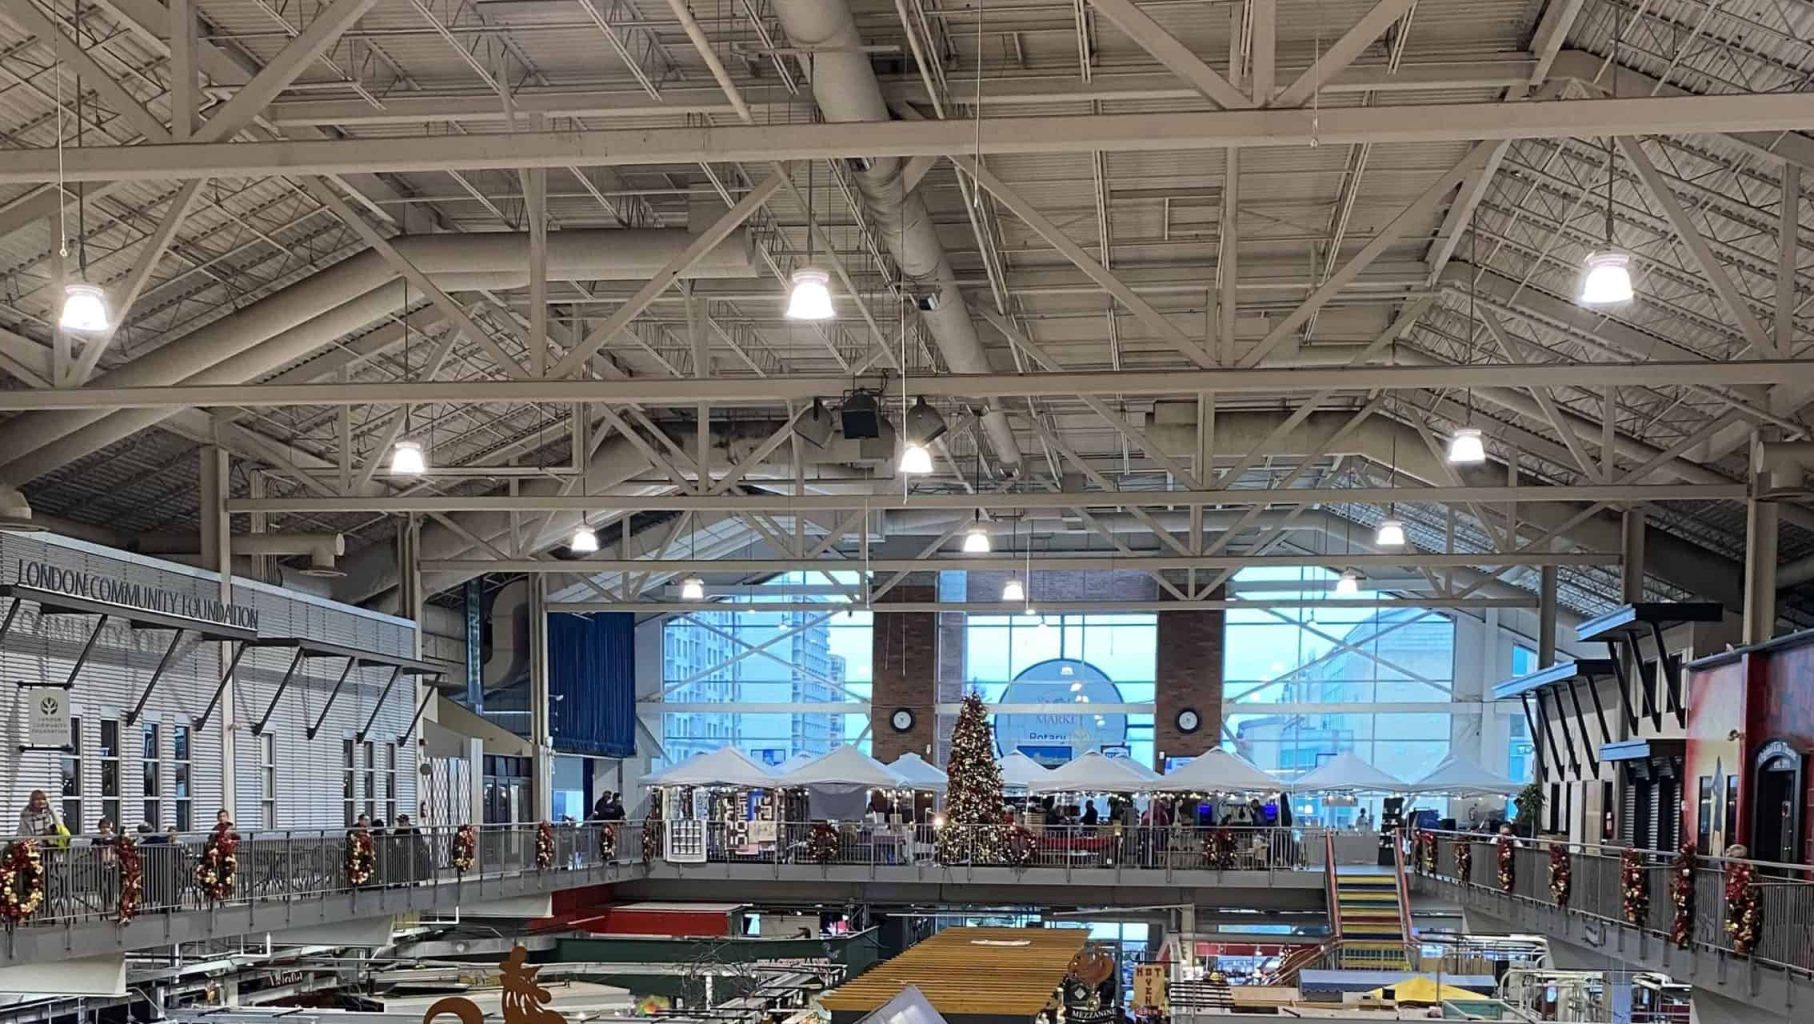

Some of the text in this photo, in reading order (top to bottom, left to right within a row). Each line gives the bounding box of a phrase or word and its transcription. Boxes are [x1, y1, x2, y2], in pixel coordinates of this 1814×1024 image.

[17, 559, 259, 630] LONDON COMMUNITY FOUNDATION
[1136, 967, 1161, 976] HOT
[1072, 1008, 1117, 1019] MEZZANINE
